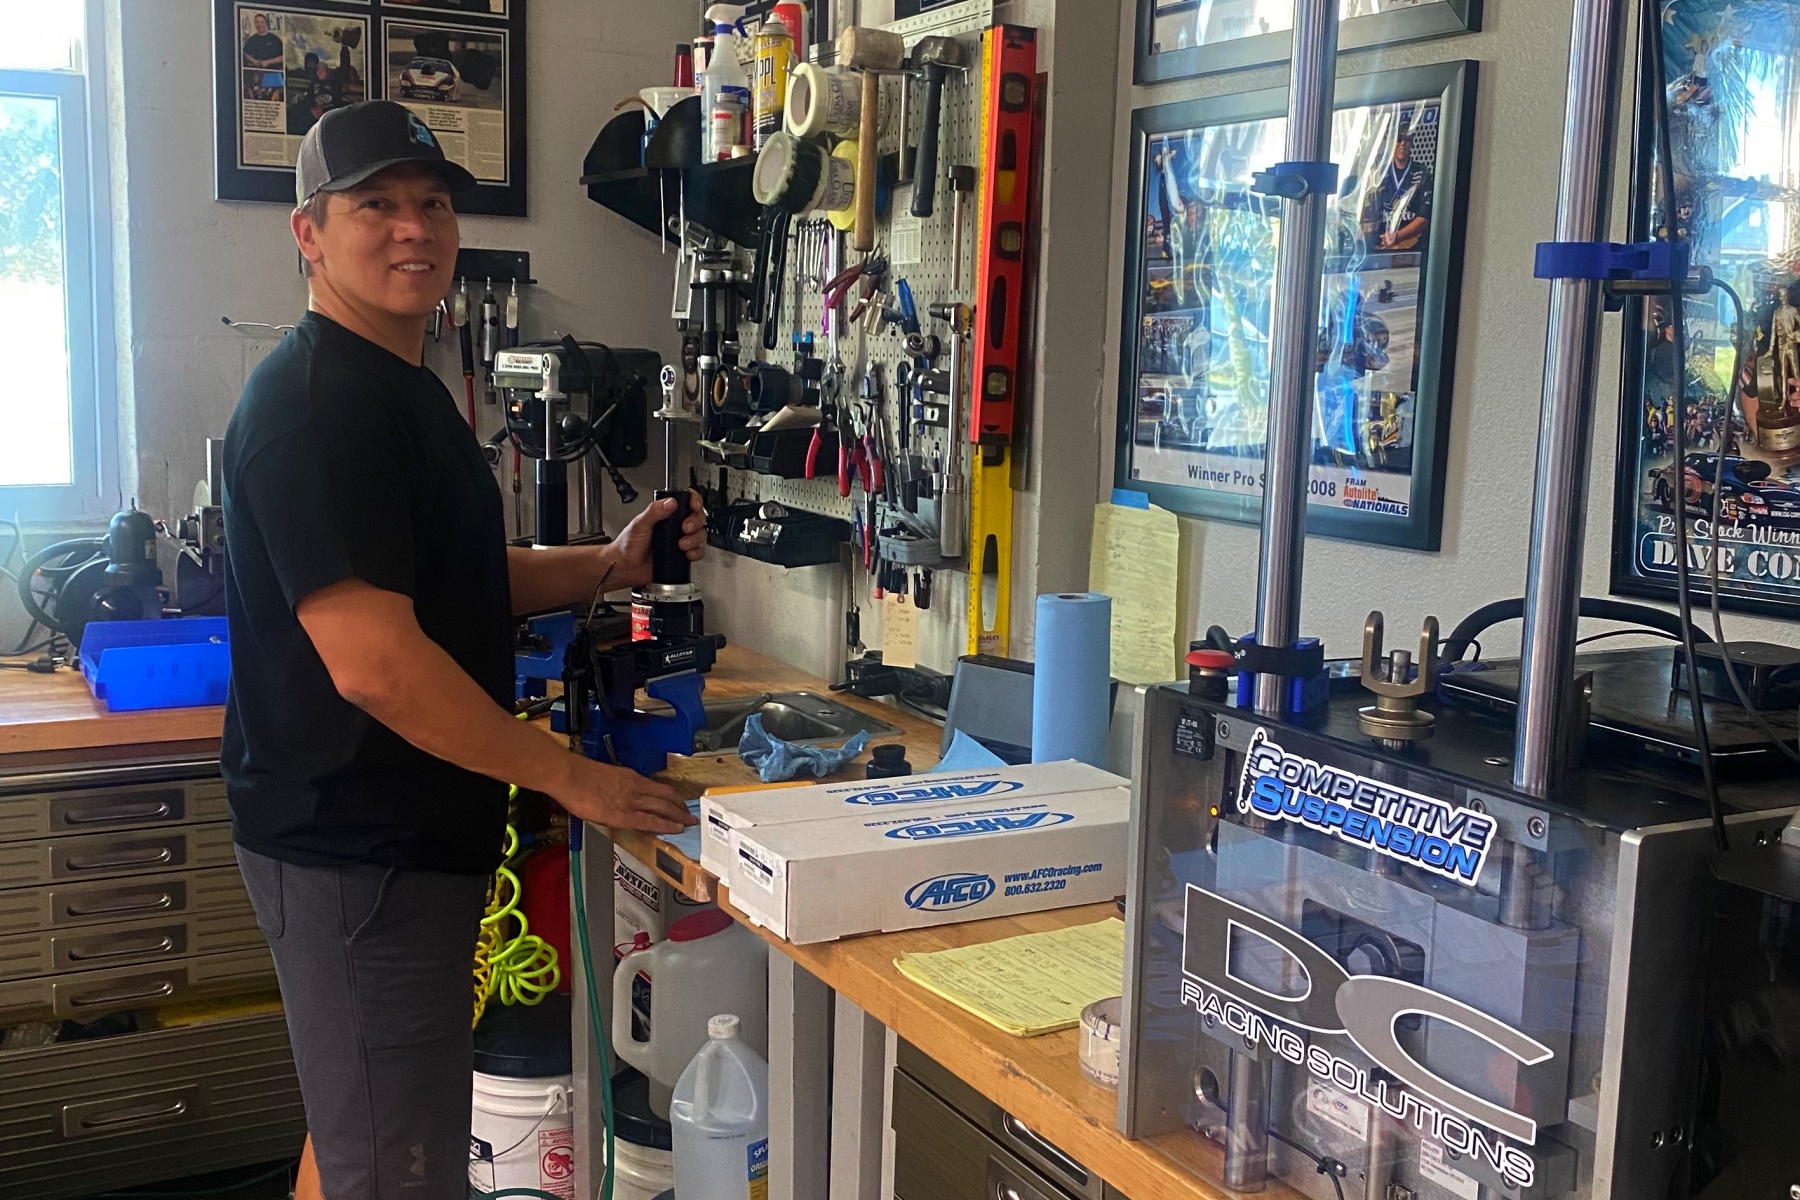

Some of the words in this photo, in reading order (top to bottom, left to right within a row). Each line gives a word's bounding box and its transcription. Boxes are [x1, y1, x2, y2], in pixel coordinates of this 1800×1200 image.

[1188, 464, 1230, 483] Winner
[1233, 472, 1255, 488] Pro
[1307, 480, 1336, 497] 008
[1343, 485, 1377, 501] Autolite
[1345, 477, 1367, 487] FRAM
[1352, 500, 1409, 516] NATIONALS
[1693, 518, 1744, 538] Stock
[1747, 550, 1800, 580] CO
[864, 780, 1003, 805] AFCO
[1253, 745, 1492, 850] COMPETITIVE
[906, 812, 1051, 840] AFCO
[1251, 775, 1481, 879] SUSPENSION
[1004, 863, 1102, 884] www.AFCOracing.com
[909, 874, 989, 909] AFCO
[1004, 879, 1066, 897] 800.632.2320
[1182, 883, 1555, 1146] DC
[1181, 977, 1304, 1066] RACING
[1307, 1045, 1535, 1189] SOLUTIONS
[549, 1129, 573, 1138] WARNIN
